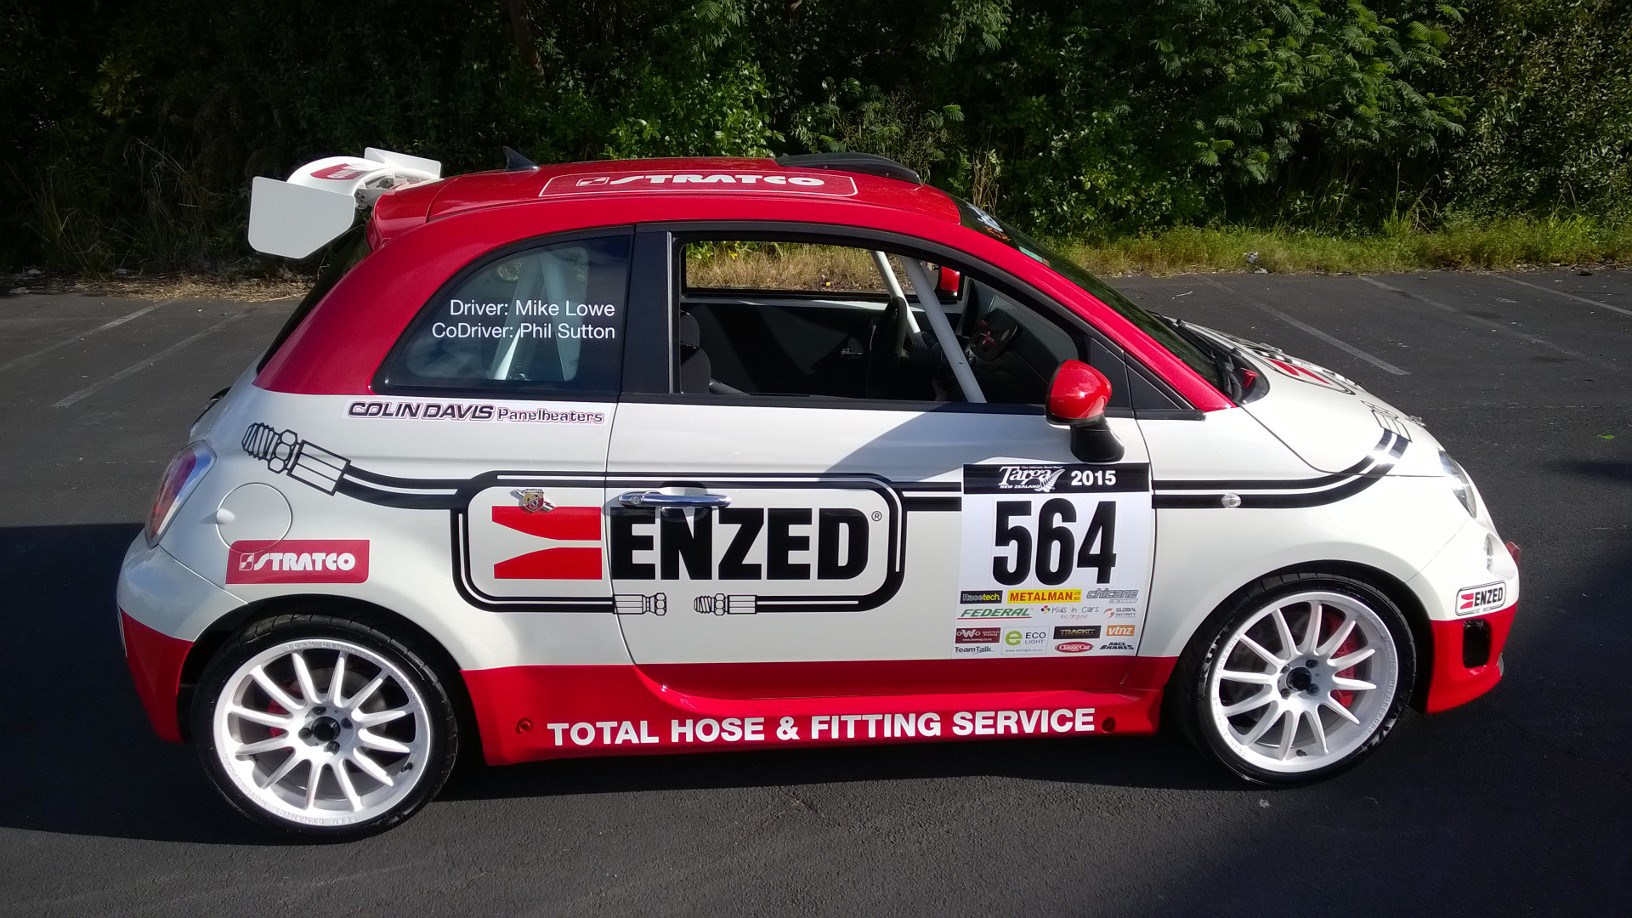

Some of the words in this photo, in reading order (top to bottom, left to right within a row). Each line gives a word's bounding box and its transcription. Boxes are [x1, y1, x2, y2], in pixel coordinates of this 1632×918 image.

[610, 174, 826, 186] STRATCO
[450, 300, 509, 316] Driver:
[515, 300, 559, 316] Mike
[565, 300, 615, 316] Lowe
[432, 322, 514, 338] CoDriver:
[520, 322, 551, 338] Phil
[557, 322, 615, 339] Sutton
[349, 402, 420, 418] COLIN
[423, 405, 493, 420] DAVIS
[497, 407, 604, 424] Panelbeaters
[999, 466, 1053, 485] Targa
[1071, 470, 1116, 486] 2015
[610, 507, 870, 580] ENZED
[992, 497, 1117, 585] 564
[254, 552, 356, 571] STRATCO
[1009, 591, 1073, 602] METALMAN
[1086, 588, 1139, 599] chicane
[1474, 587, 1504, 607] ENZED
[960, 608, 1031, 617] FEDERAL
[1108, 627, 1132, 636] vtnz
[547, 720, 659, 746] TOTAL
[671, 717, 765, 743] HOSE
[776, 716, 800, 741] &
[811, 712, 941, 739] FITTING
[952, 707, 1095, 736] SERVICE
